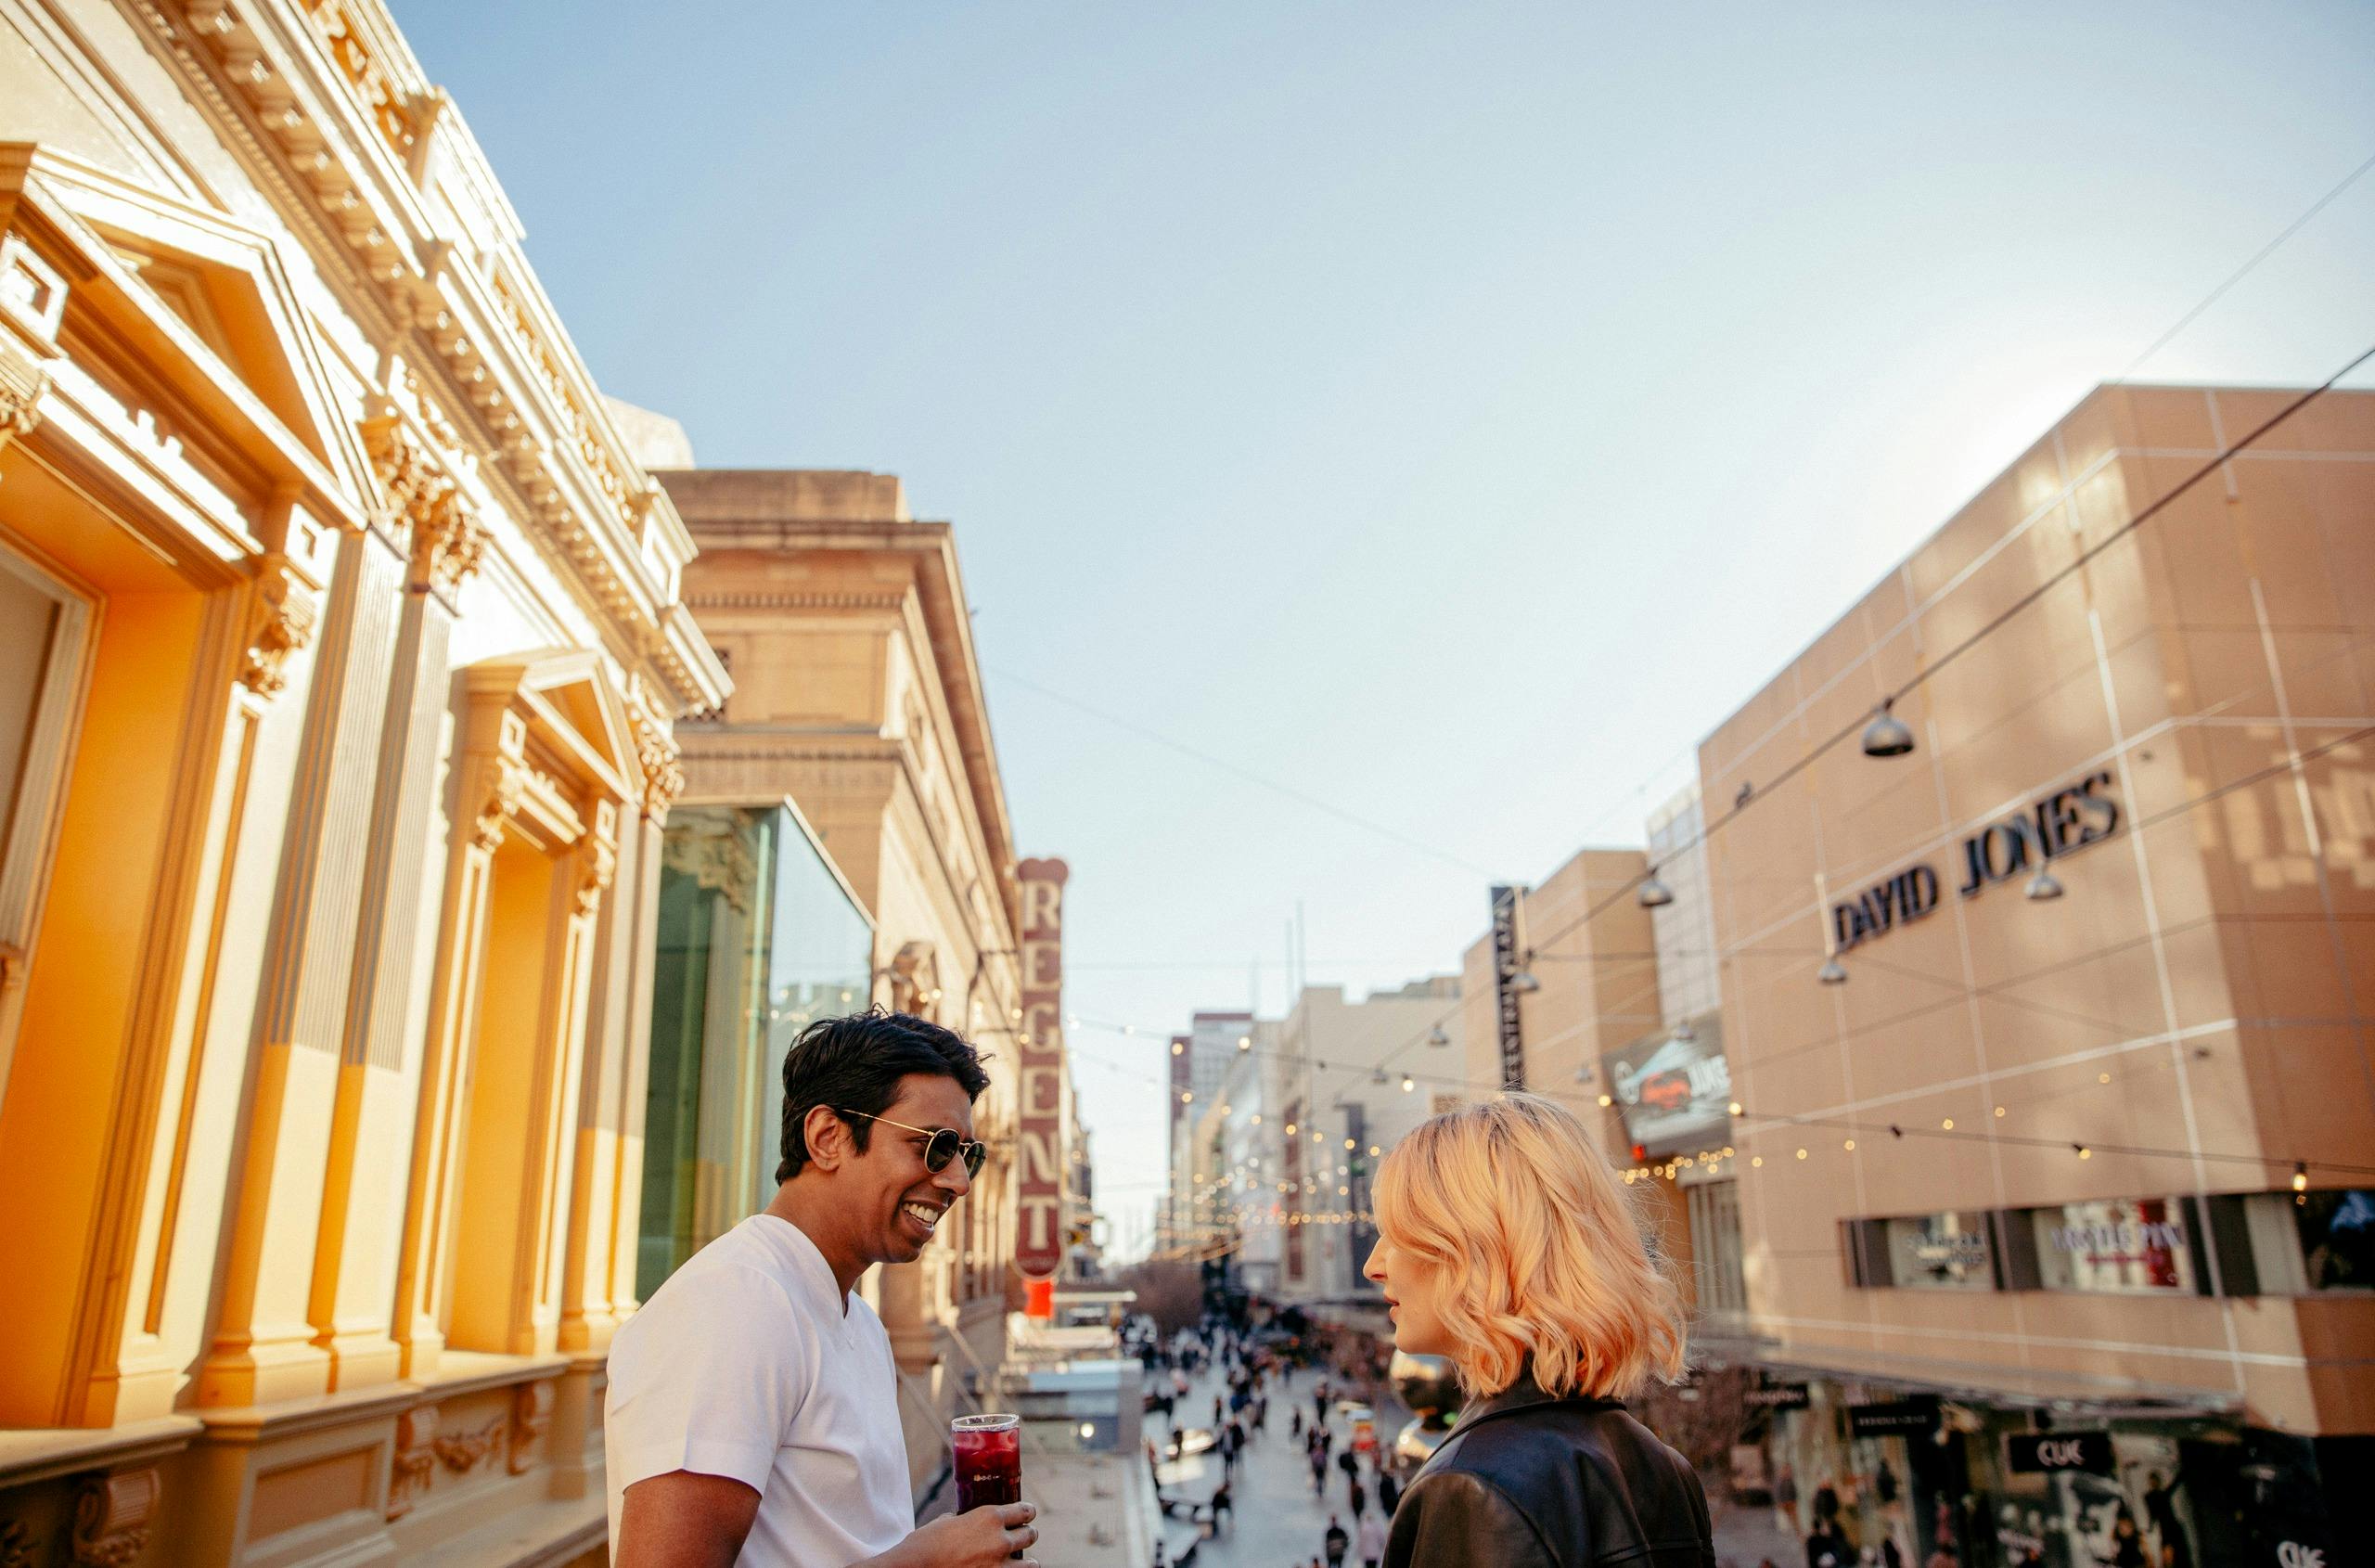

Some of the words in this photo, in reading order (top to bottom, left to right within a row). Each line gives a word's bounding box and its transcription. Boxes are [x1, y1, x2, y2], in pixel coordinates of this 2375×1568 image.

[1834, 865, 1939, 954] DAVID
[1959, 771, 2119, 897] JONES
[1022, 881, 1059, 1251] REGENT
